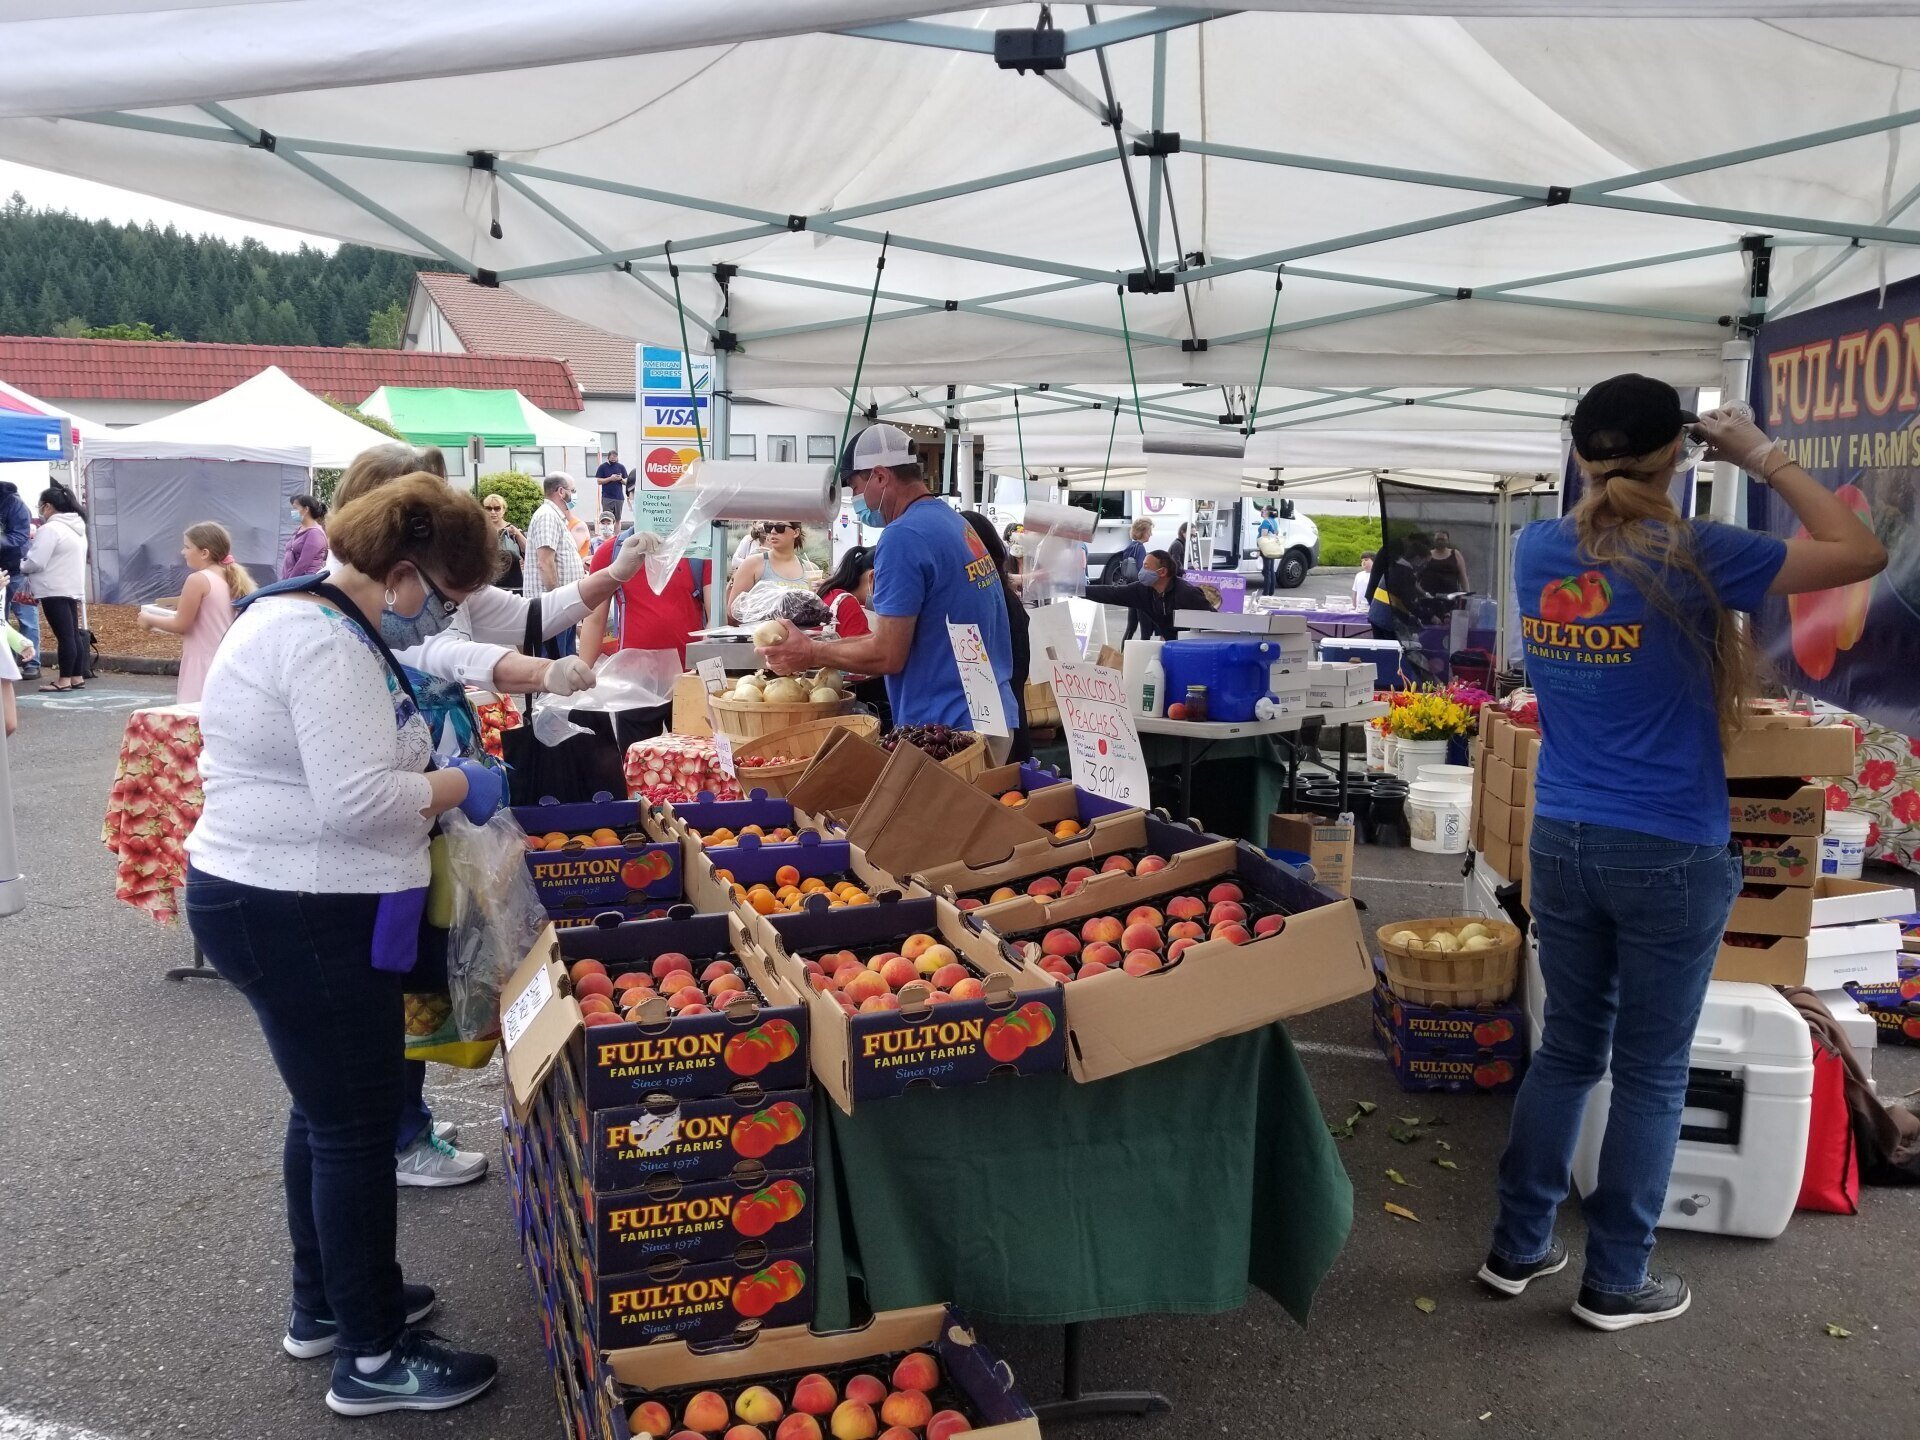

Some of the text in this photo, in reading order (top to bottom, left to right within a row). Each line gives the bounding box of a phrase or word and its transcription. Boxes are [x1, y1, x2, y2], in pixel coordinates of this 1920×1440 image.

[654, 408, 698, 425] VISA
[1780, 436, 1842, 469] FAMILY
[647, 463, 690, 473] MasterC
[976, 504, 996, 515] Ta
[1521, 616, 1643, 650] FULTON
[1527, 644, 1632, 664] FAMILY FARMS
[1053, 665, 1117, 701] APRICOTS
[1065, 698, 1119, 738] PEACHES
[533, 858, 622, 879] FULTON
[1744, 866, 1777, 878] ERRIES
[542, 875, 616, 888] FAMILY FARMS
[557, 887, 600, 897] Since 1978
[1408, 1019, 1474, 1033] FULTON
[1869, 1010, 1904, 1025] TON
[1877, 1022, 1899, 1030] ARMS
[862, 1017, 984, 1057] FULTON
[1414, 1031, 1442, 1039] FAMILY
[598, 1032, 724, 1066] FULTON
[874, 1043, 976, 1069] FAMILY FARMS
[610, 1056, 716, 1078] FAMILY FARMS
[895, 1061, 954, 1079] Since 1978
[1410, 1061, 1474, 1074] FULTON
[631, 1073, 693, 1089] Since 1978
[606, 1114, 732, 1149] FUTON
[675, 1138, 723, 1154] FARMS
[639, 1155, 700, 1172] Since 1978
[608, 1194, 733, 1232] FULTON
[620, 1219, 725, 1243] FAMILY FARMS
[641, 1236, 702, 1254] Since 1978
[609, 1276, 733, 1314] FULTON
[621, 1300, 725, 1325] FAMILY FARMS
[641, 1317, 702, 1335] Since 1978
